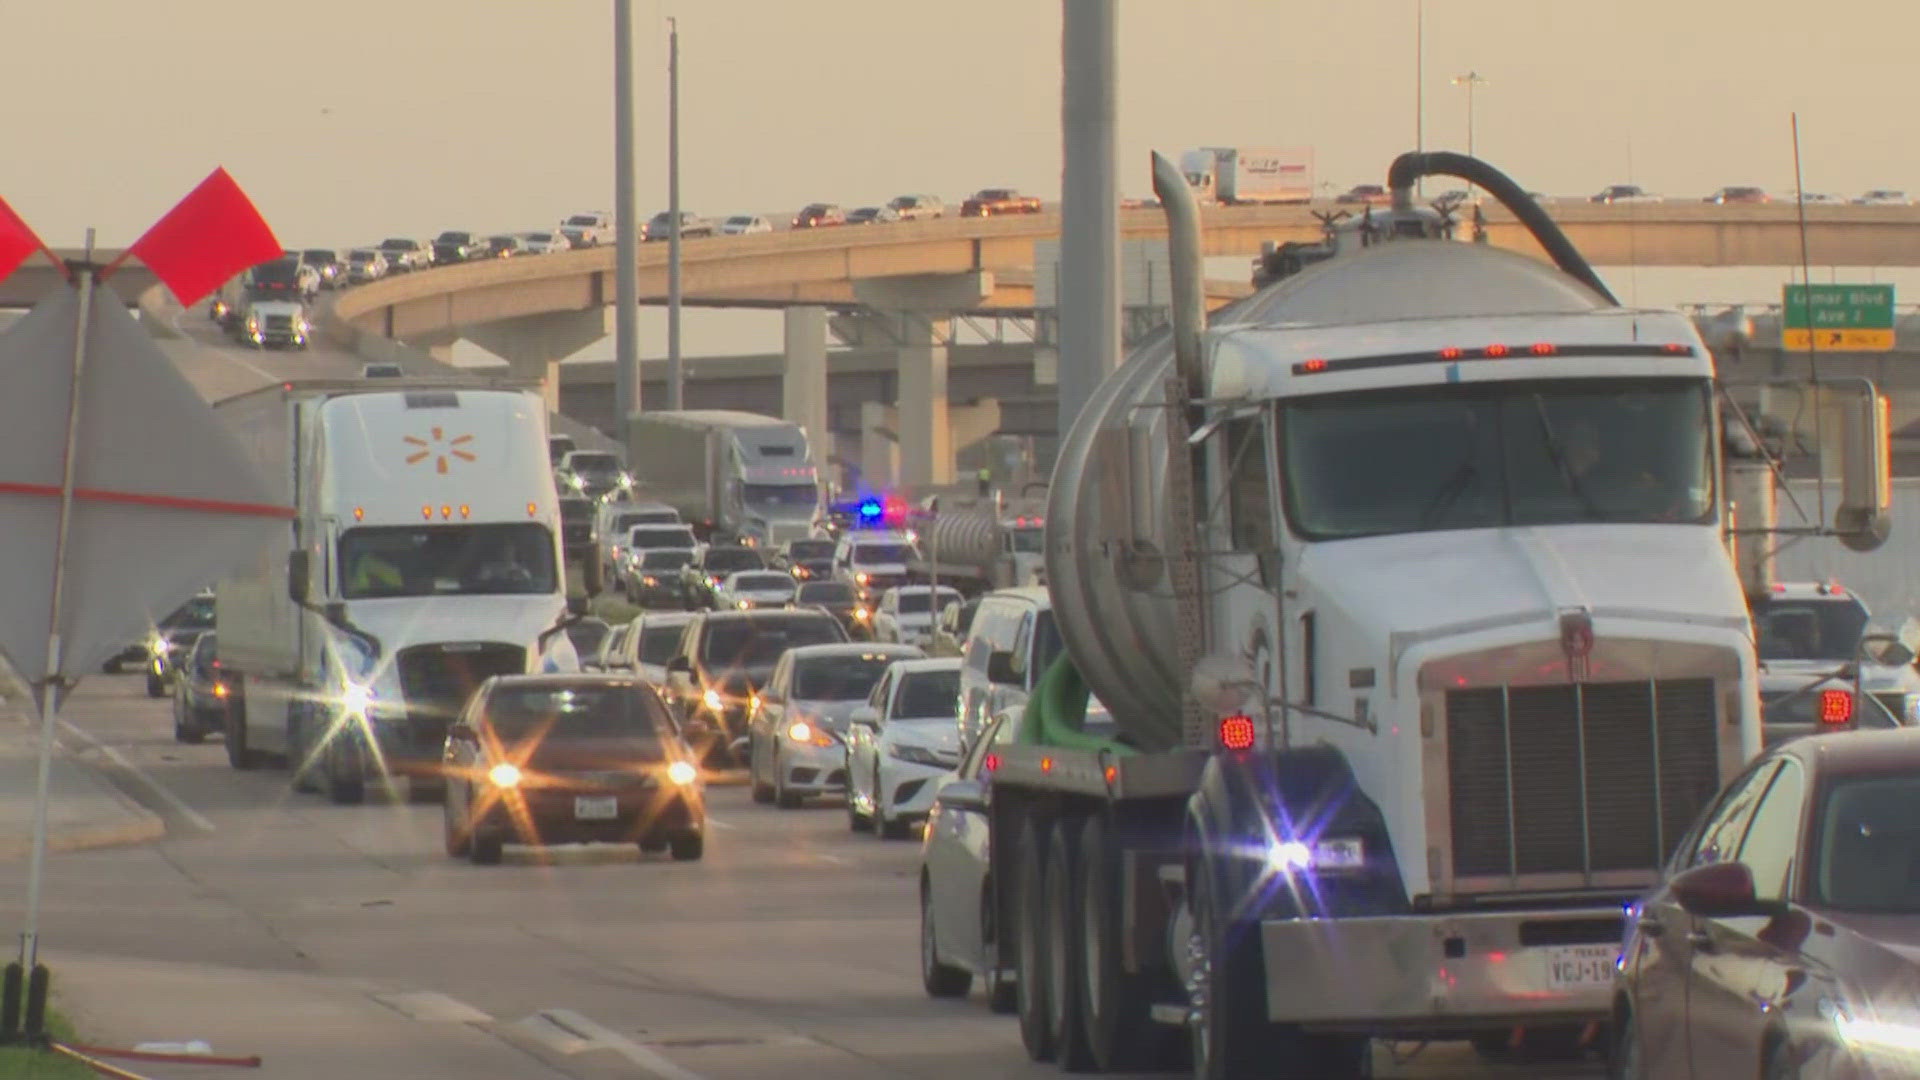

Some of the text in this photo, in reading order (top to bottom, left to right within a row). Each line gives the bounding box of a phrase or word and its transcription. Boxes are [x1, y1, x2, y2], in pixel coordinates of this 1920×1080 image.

[1849, 291, 1885, 305] Blvd
[1816, 309, 1846, 322] Ave
[1574, 948, 1607, 957] TEXAS
